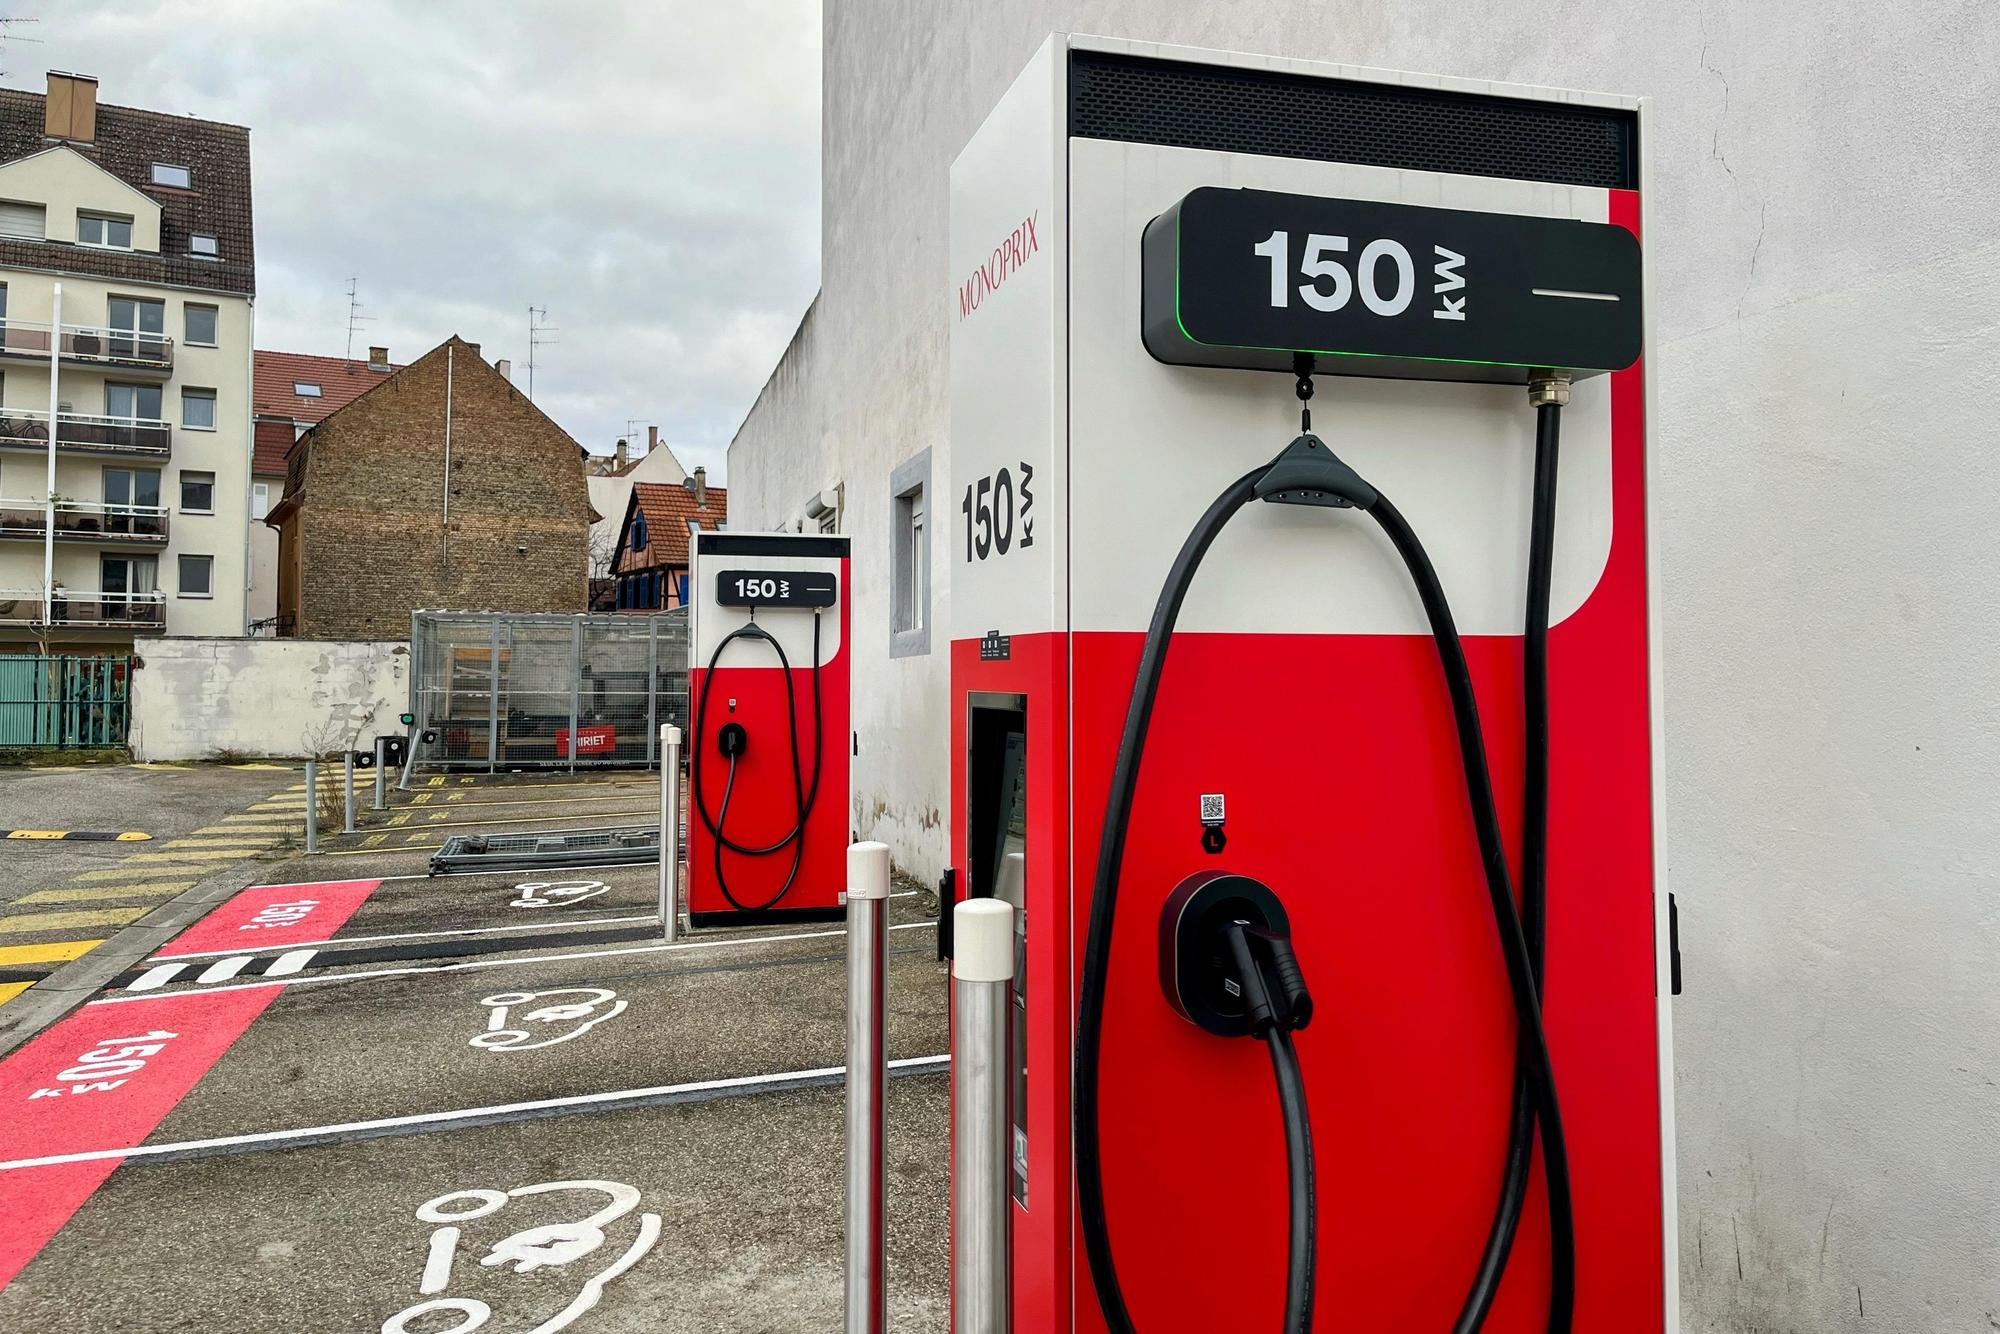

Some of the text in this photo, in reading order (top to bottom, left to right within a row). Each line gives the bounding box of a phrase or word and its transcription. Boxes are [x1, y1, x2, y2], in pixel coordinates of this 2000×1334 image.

[959, 209, 1039, 323] MONOPRIX
[1254, 230, 1466, 321] 150 kW
[962, 461, 1034, 563] 150 kW
[735, 578, 790, 598] 150 kW
[1211, 835, 1219, 847] L
[250, 899, 321, 923] 150
[56, 1029, 180, 1081] 150
